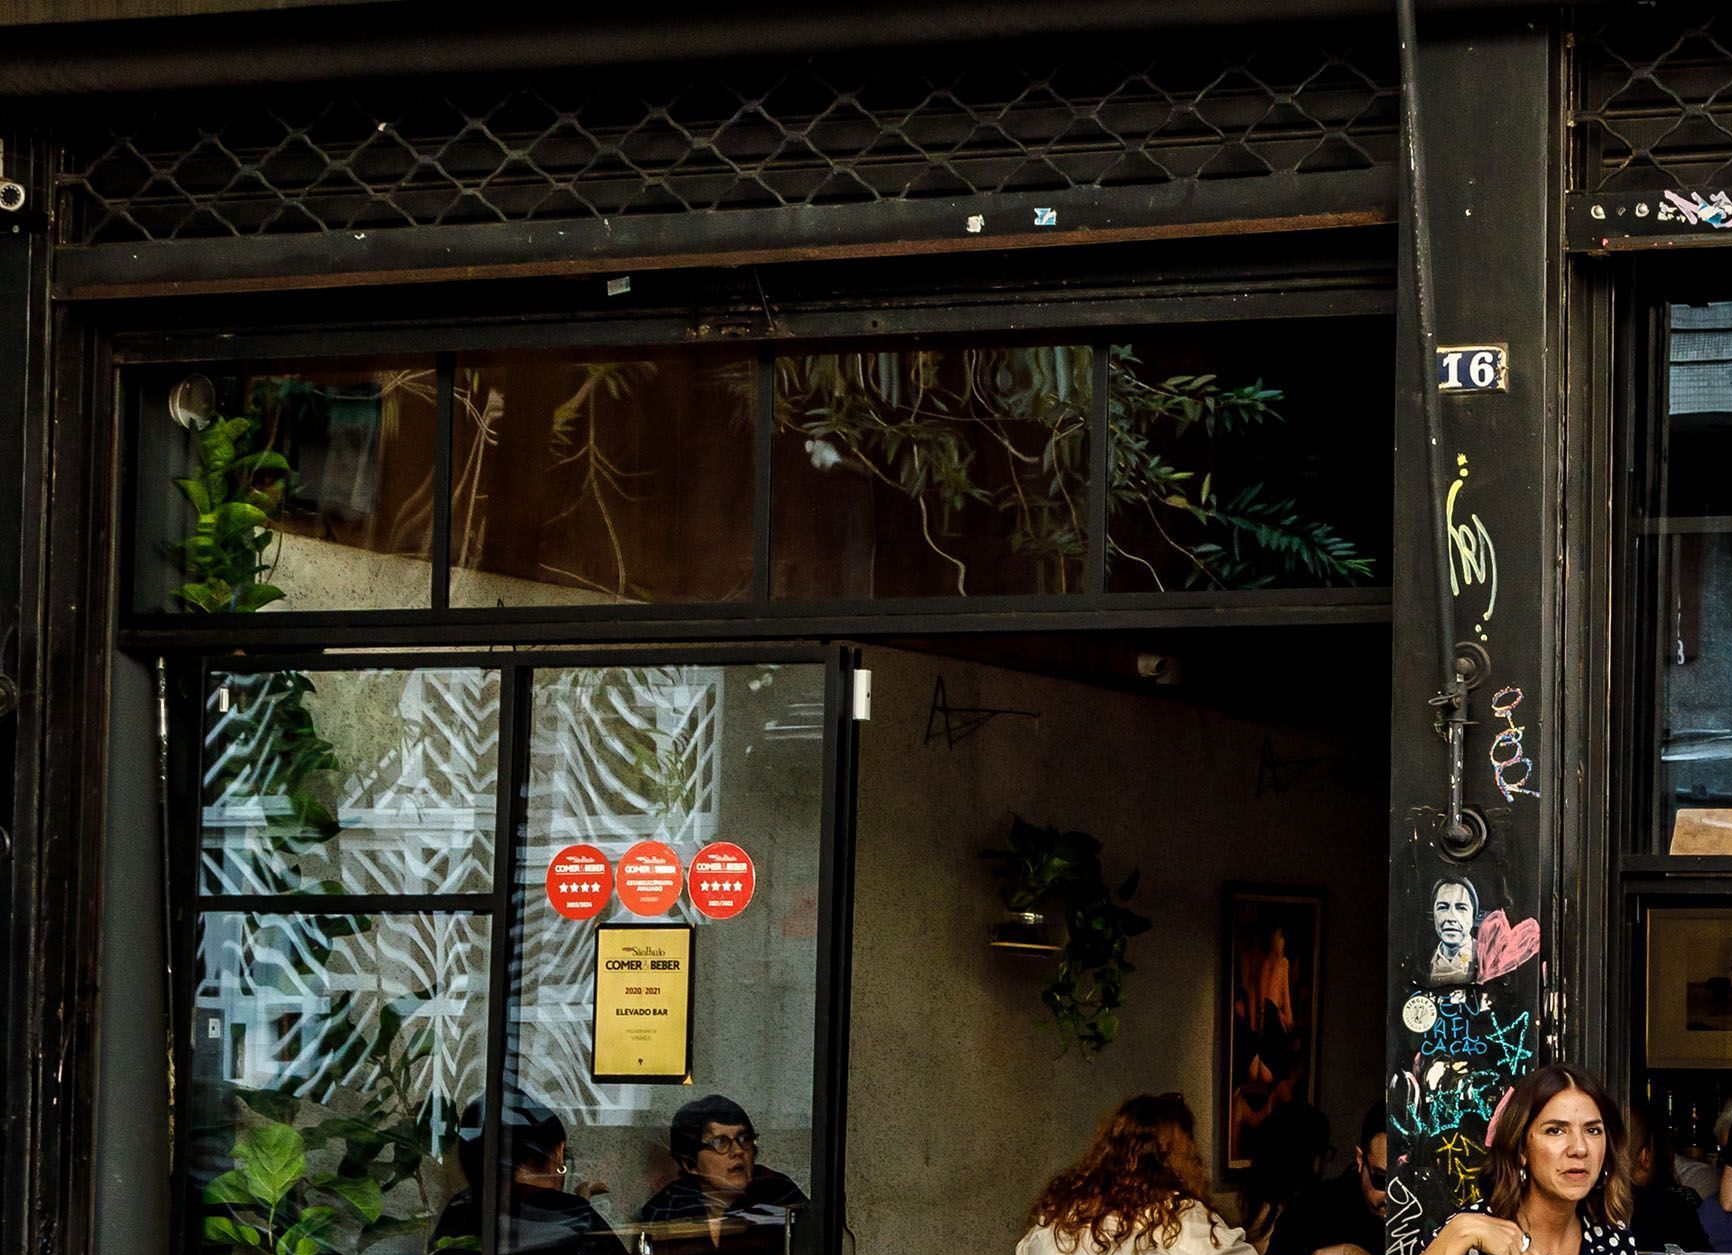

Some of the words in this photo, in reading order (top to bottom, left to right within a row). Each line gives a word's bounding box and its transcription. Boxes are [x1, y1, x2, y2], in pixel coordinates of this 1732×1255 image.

[1442, 351, 1495, 387] 16
[605, 960, 642, 970] COMER
[650, 960, 680, 970] BEBER
[616, 1008, 651, 1016] ELEVADO
[653, 1008, 668, 1016] BAR
